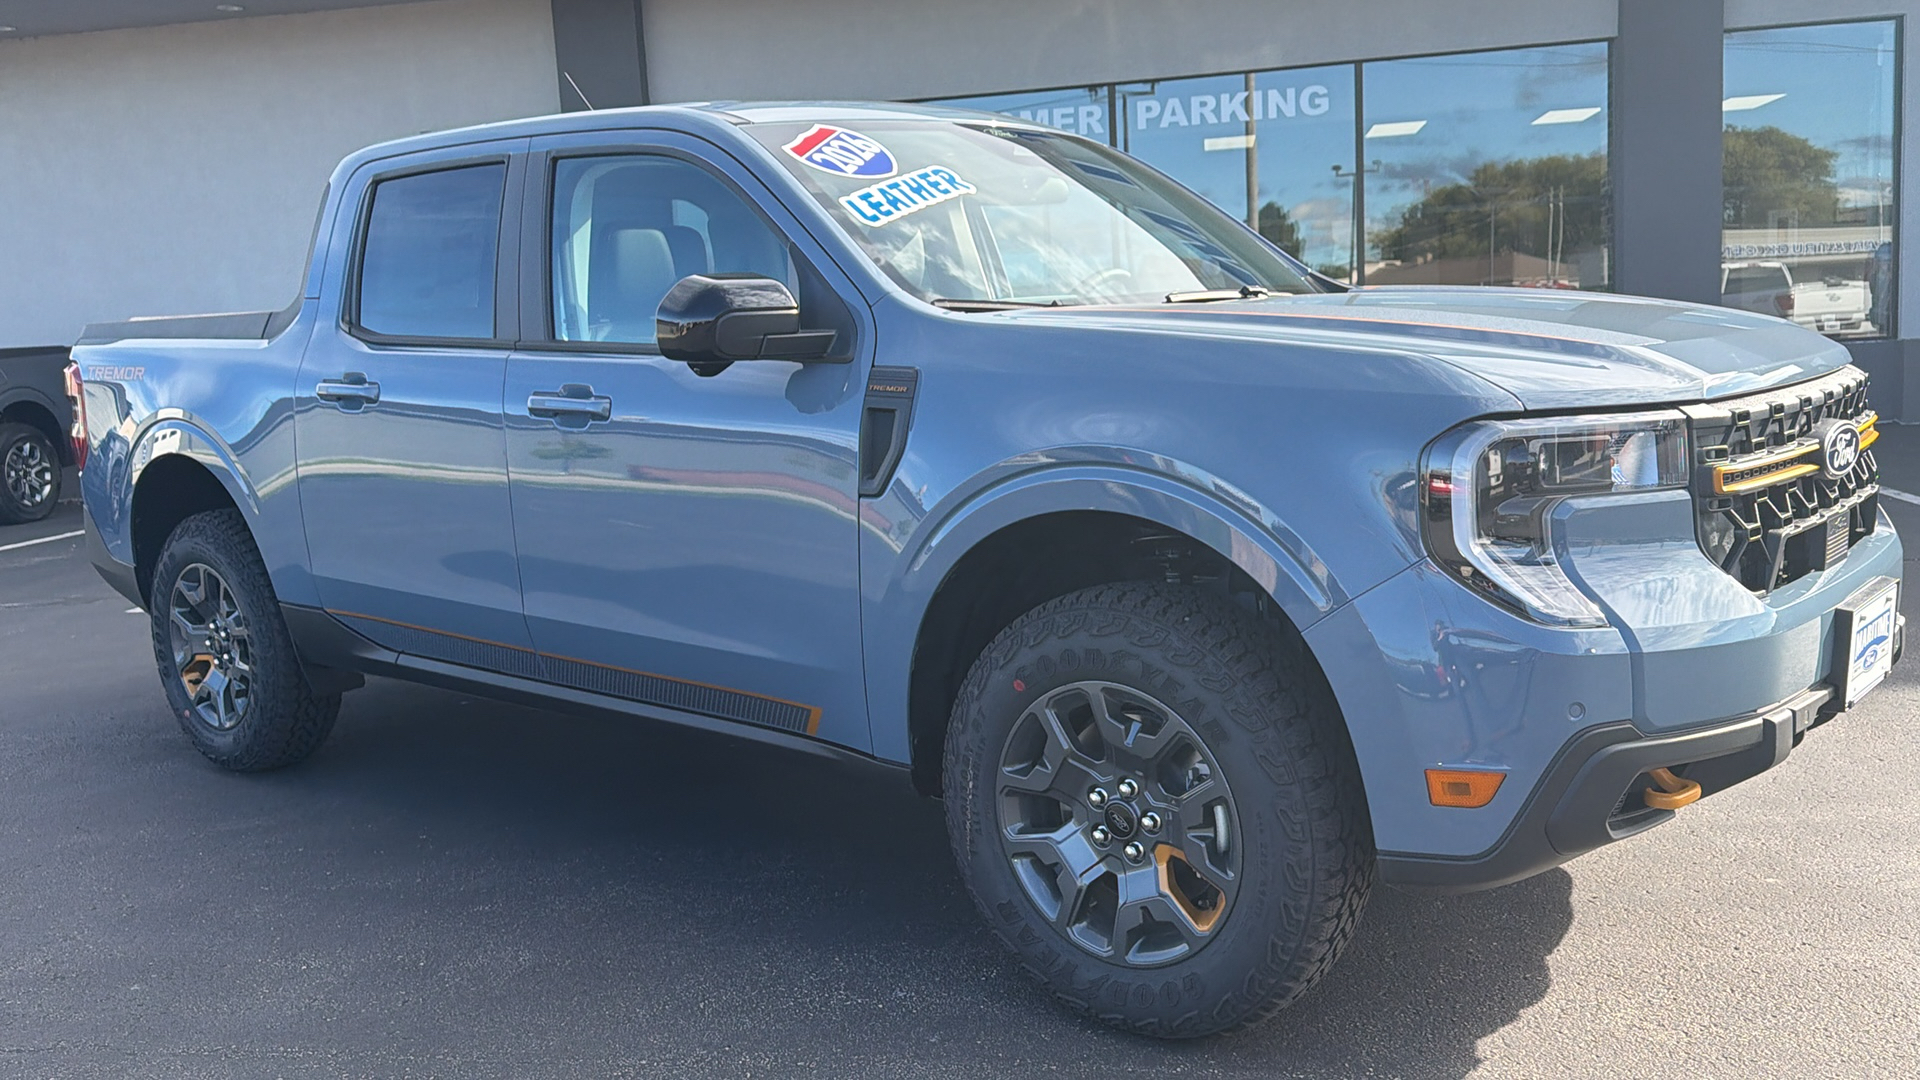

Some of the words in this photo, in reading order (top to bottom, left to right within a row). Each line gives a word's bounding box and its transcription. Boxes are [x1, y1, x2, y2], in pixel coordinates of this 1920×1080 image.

[1000, 105, 1105, 135] MER
[1136, 84, 1330, 130] PARKING
[811, 132, 881, 175] 2026
[846, 168, 971, 223] LEATHER
[87, 366, 145, 381] TREMOR
[868, 384, 909, 393] TREMOR
[1832, 431, 1857, 469] Ford
